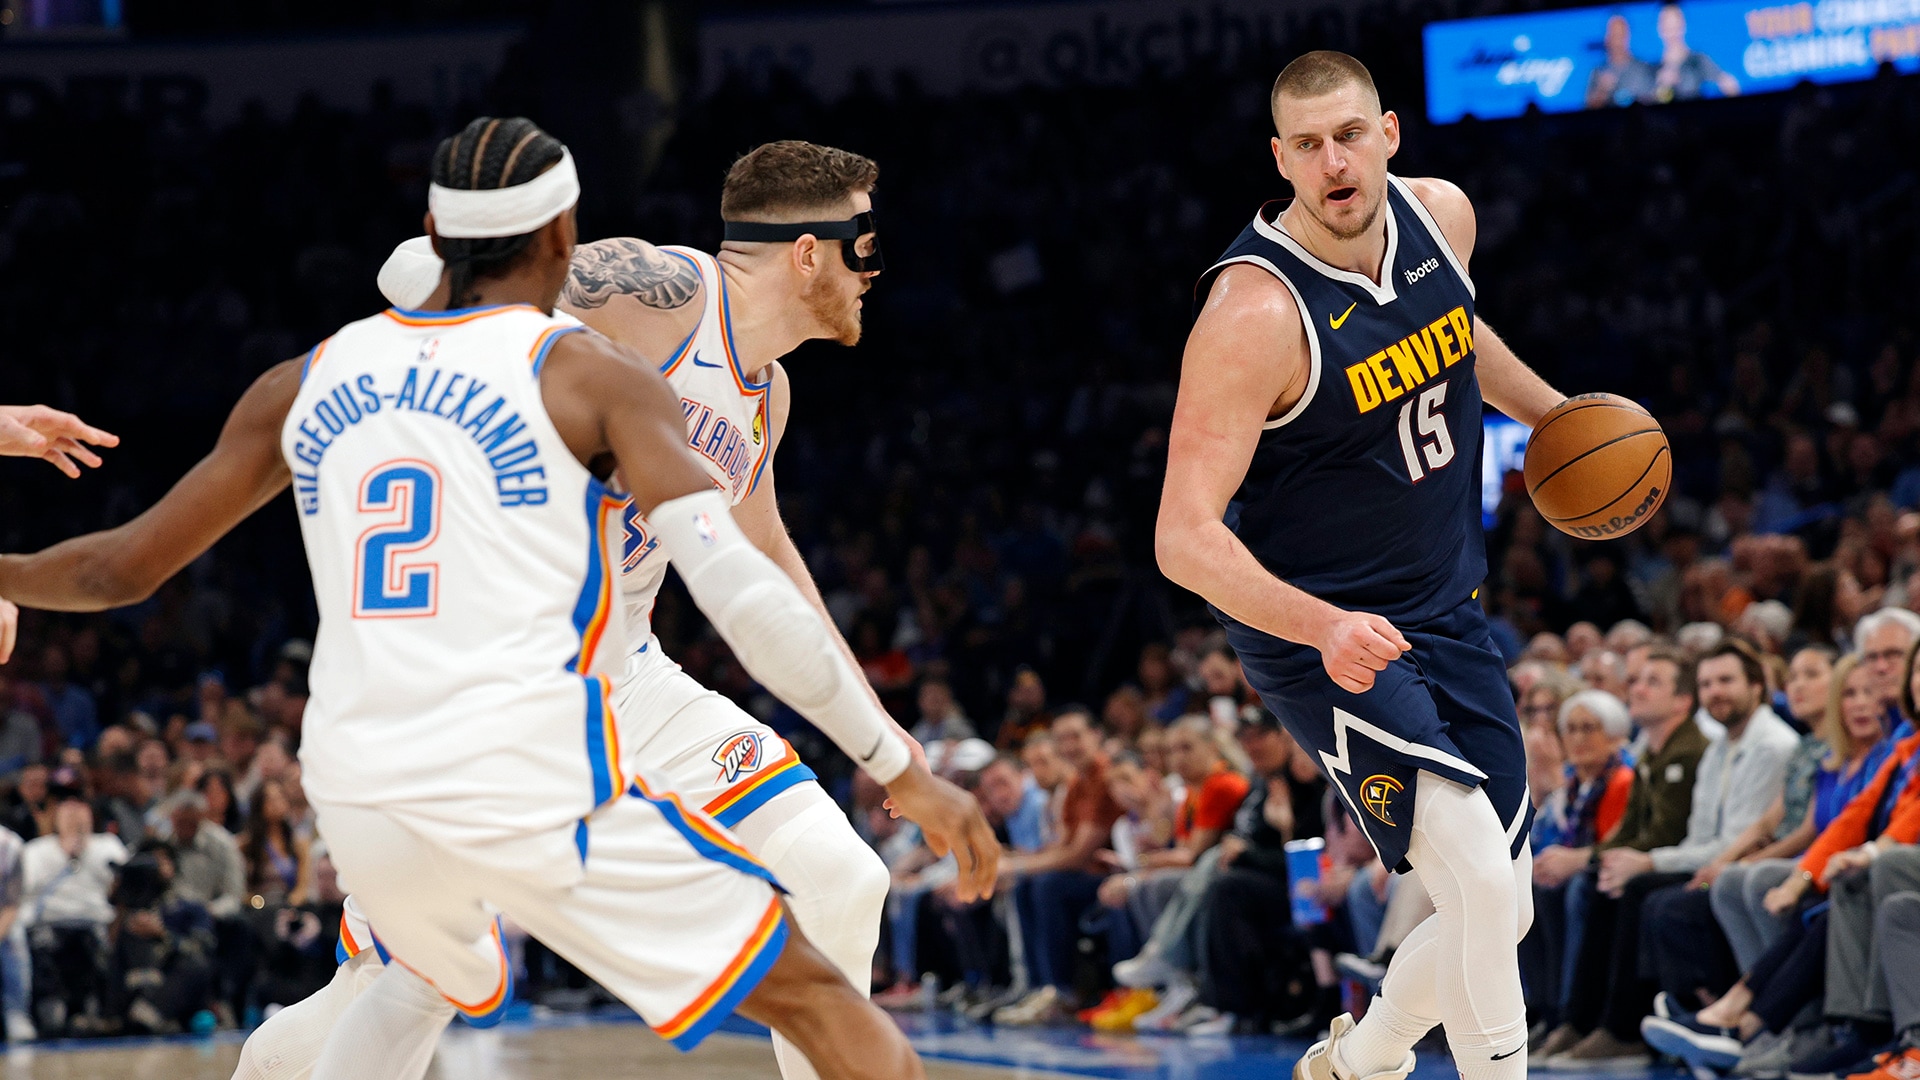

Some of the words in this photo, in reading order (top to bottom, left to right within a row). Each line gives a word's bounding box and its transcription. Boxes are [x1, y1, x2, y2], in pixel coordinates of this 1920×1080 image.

[1404, 256, 1440, 285] ibotta
[1344, 305, 1474, 415] DENVER
[295, 367, 549, 516] GILGEOUS-ALEXANDER
[1398, 379, 1455, 484] 15
[352, 457, 442, 619] 2
[1568, 486, 1661, 538] Wilson
[724, 735, 753, 783] OKC
